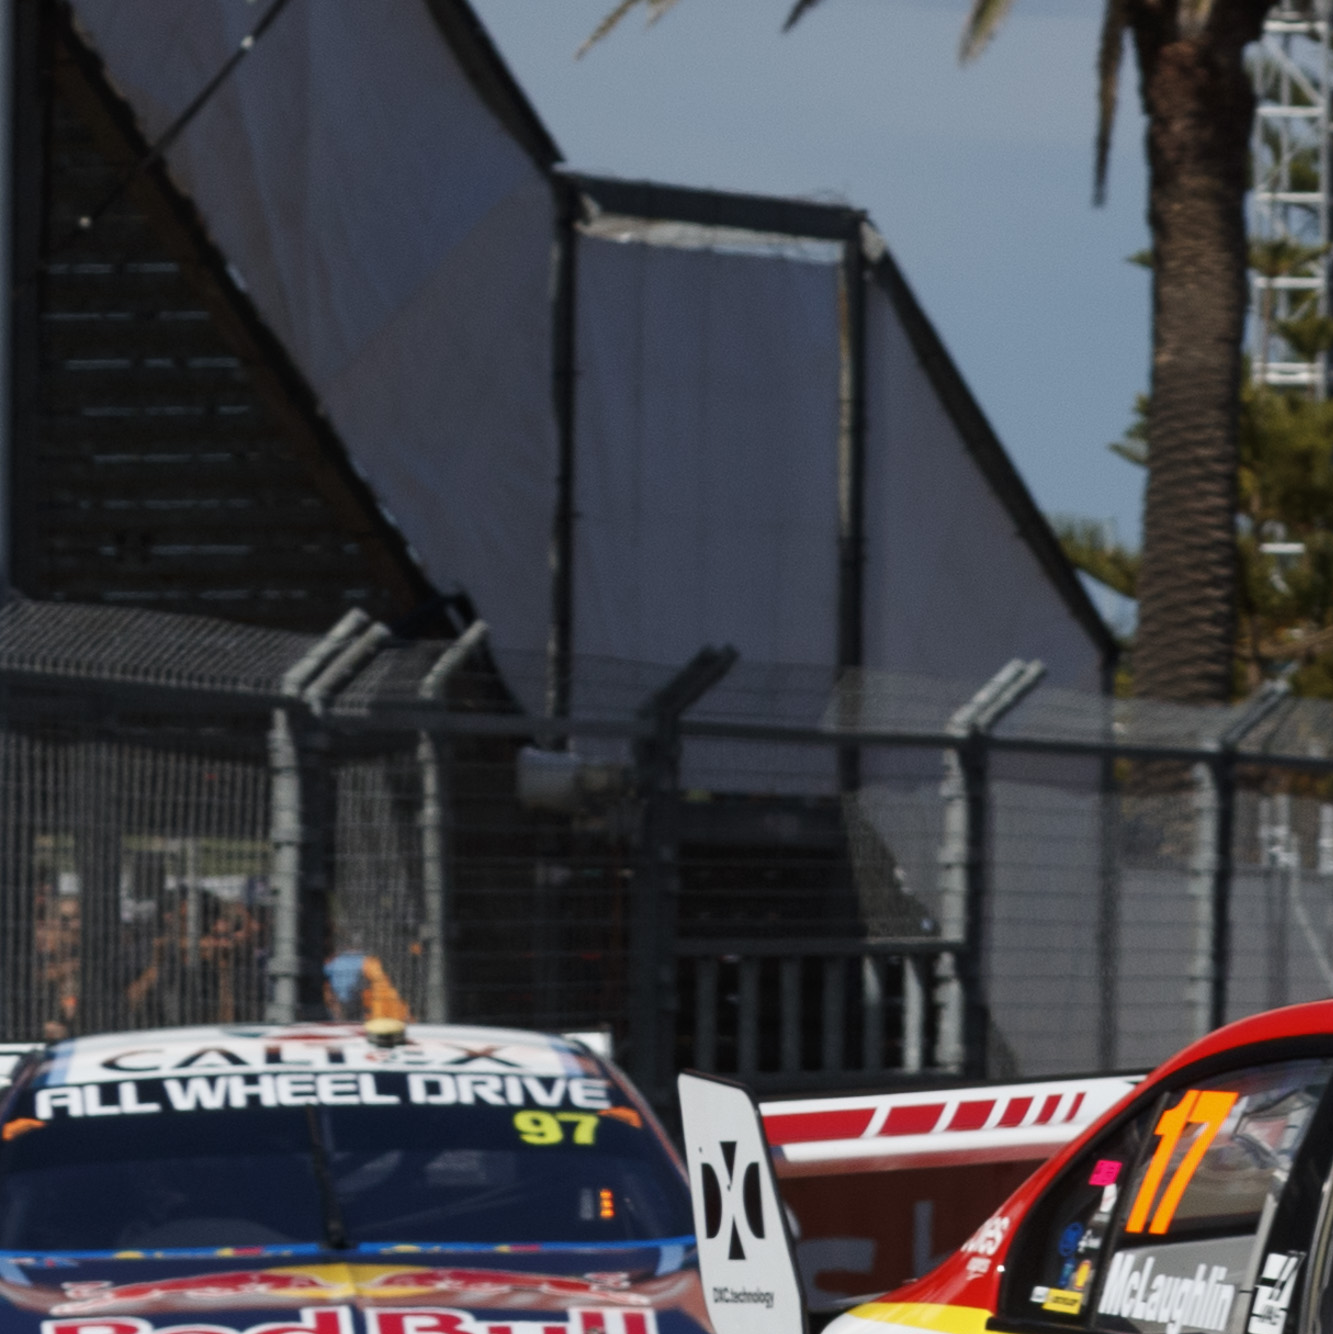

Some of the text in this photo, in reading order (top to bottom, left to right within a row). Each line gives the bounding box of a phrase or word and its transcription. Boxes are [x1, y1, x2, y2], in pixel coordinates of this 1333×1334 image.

[35, 1072, 611, 1119] ALL WHEEL DRIVE
[513, 1110, 600, 1145] 97
[1125, 1089, 1239, 1234] 17
